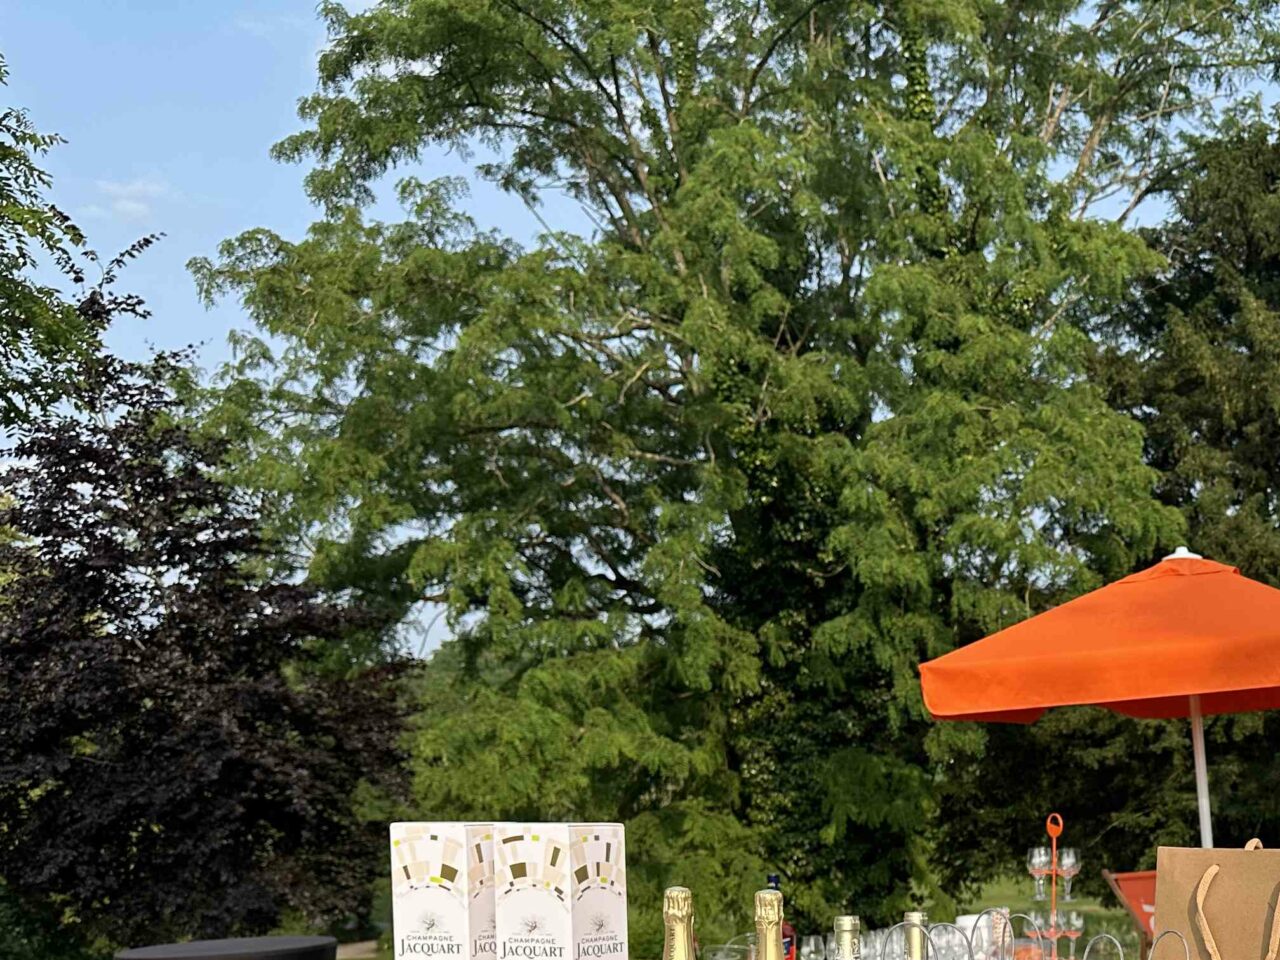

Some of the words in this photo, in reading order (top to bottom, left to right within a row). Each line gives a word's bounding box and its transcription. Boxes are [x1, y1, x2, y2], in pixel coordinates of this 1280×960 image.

[399, 938, 463, 956] JACQUART
[581, 935, 618, 944] CHAMPAGNE
[500, 941, 565, 960] JACQUART
[575, 942, 625, 960] JACQUART
